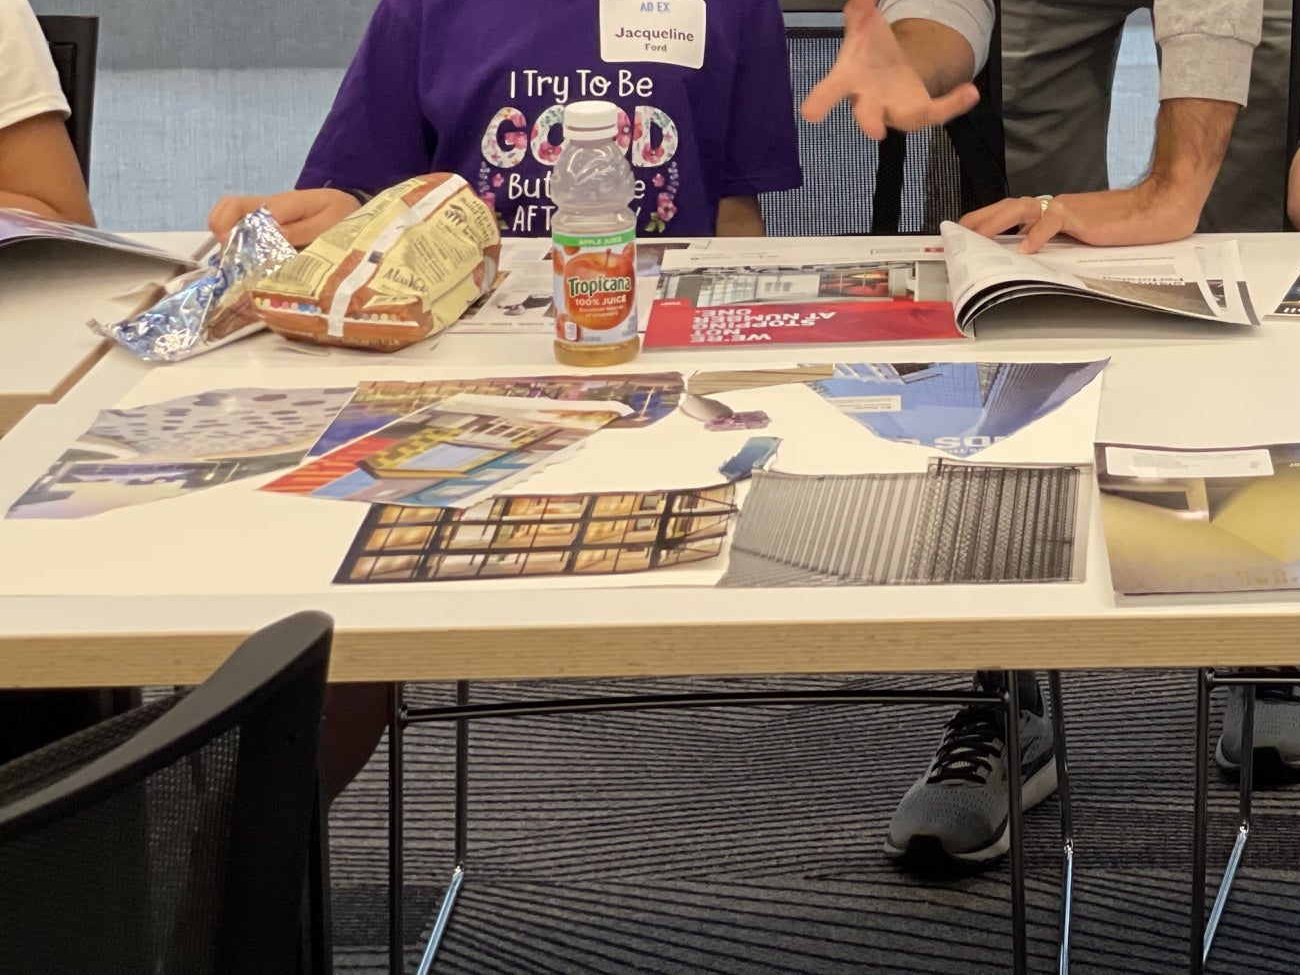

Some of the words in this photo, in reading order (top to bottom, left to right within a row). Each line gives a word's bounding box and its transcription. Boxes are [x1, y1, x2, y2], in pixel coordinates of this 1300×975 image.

[640, 1, 654, 12] AD
[656, 2, 671, 13] EX
[615, 27, 694, 42] Jacqueline
[645, 43, 667, 52] Ford
[510, 71, 516, 99] I
[523, 70, 569, 104] Try
[576, 70, 611, 96] To
[618, 70, 653, 97] Be
[512, 204, 557, 232] AFT
[567, 275, 631, 297] Tropicana
[575, 298, 600, 307] 100%
[602, 295, 627, 306] JUICE
[692, 313, 800, 324] NUMBER
[805, 311, 837, 321] AT
[691, 319, 816, 329] STOPPING
[690, 328, 741, 336] NOT
[689, 333, 772, 343] WE'RE
